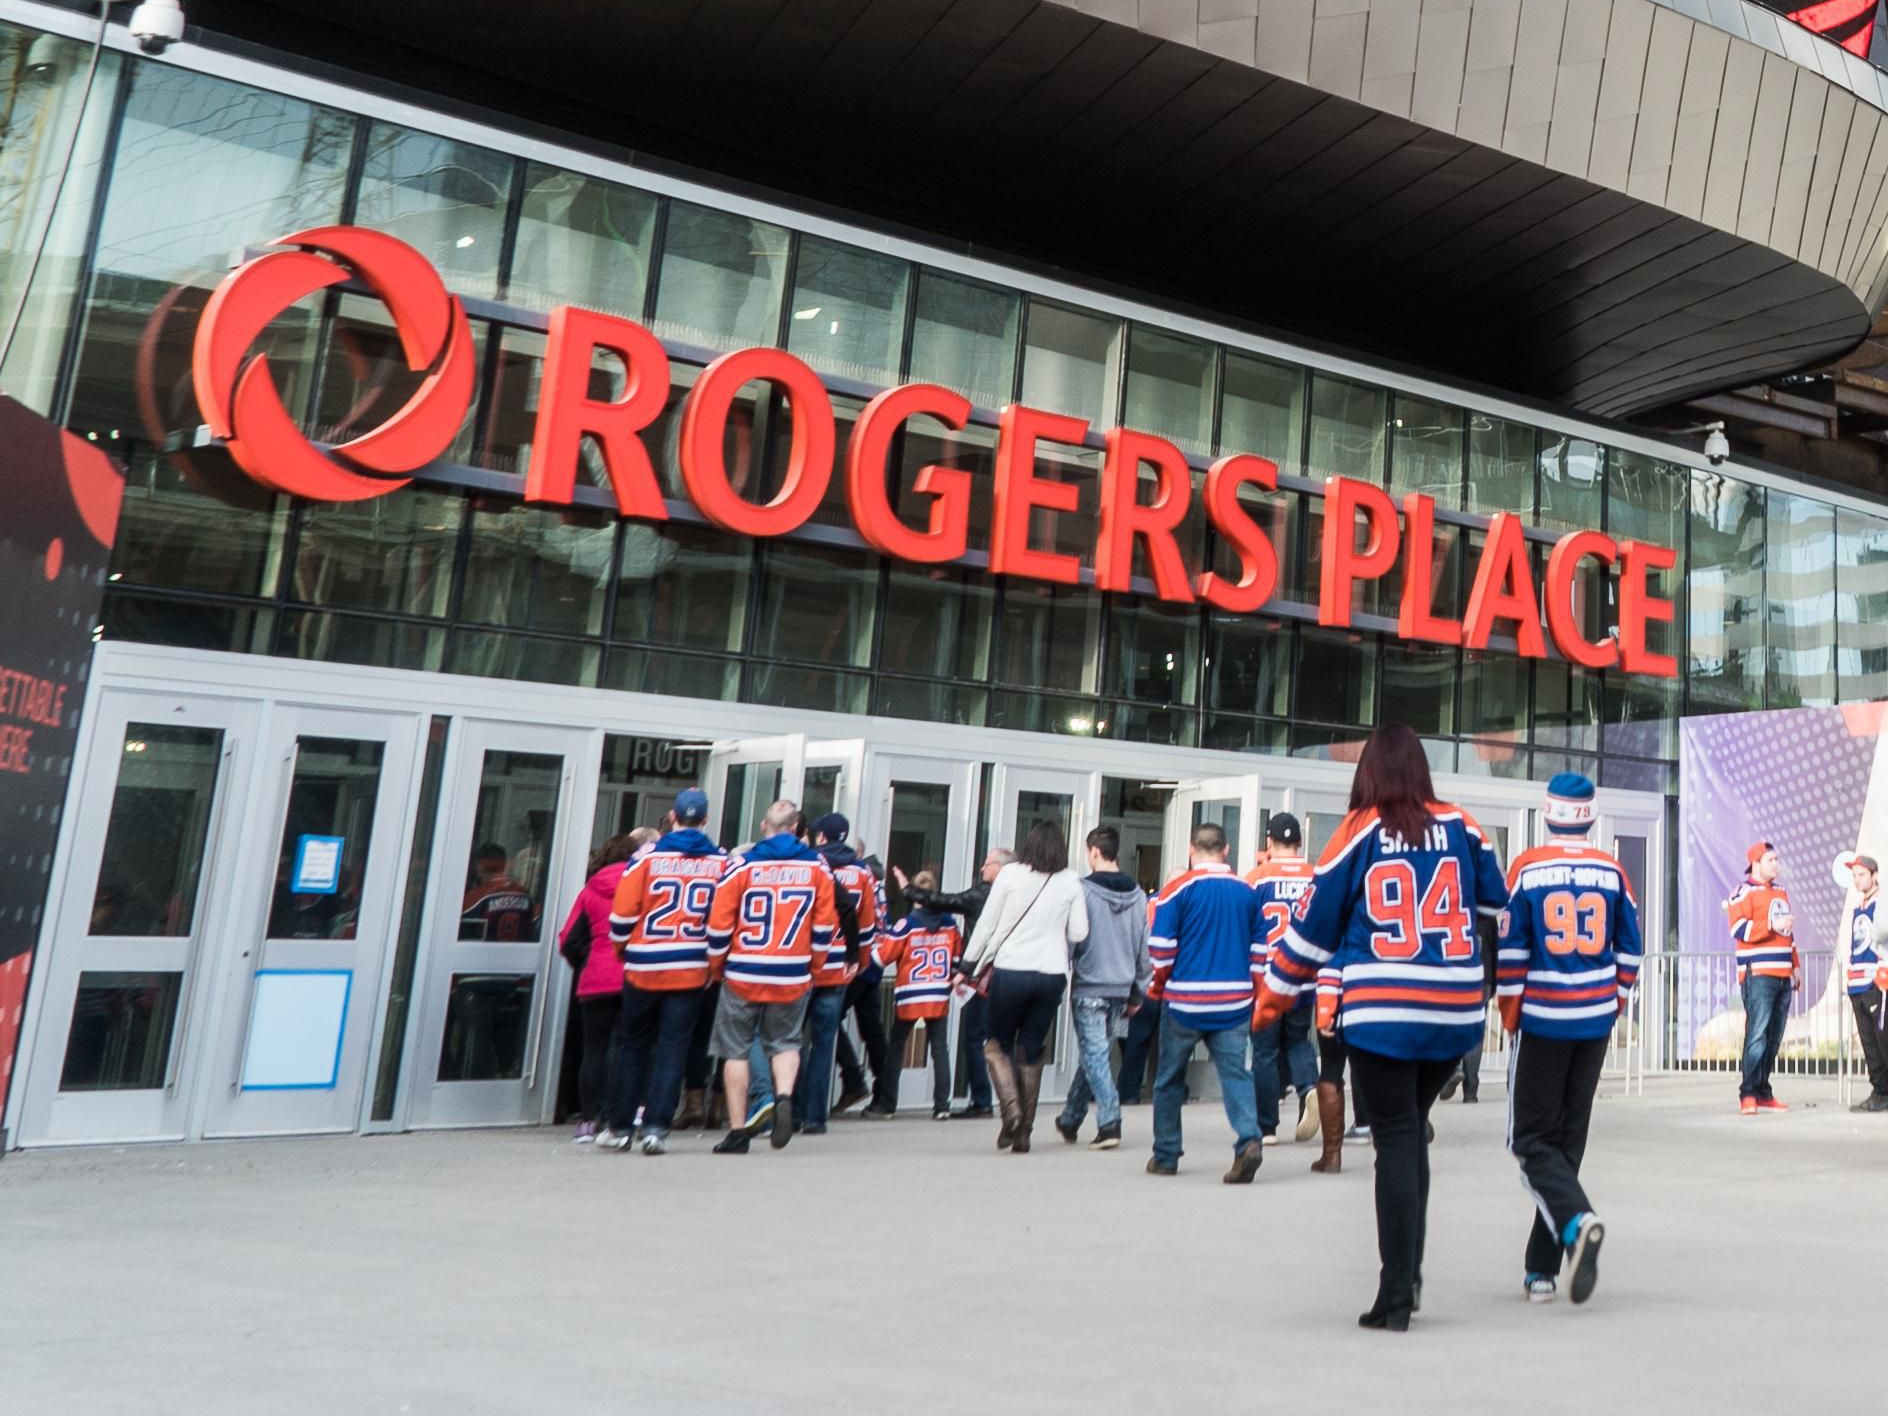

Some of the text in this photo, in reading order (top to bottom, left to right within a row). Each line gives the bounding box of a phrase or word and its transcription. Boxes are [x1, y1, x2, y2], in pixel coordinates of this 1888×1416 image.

[525, 306, 1678, 678] ROGERS PLACE
[643, 877, 718, 940] 29
[738, 886, 816, 950] 97
[1365, 857, 1474, 961] 94
[1543, 891, 1607, 955] 93
[909, 946, 951, 984] 29
